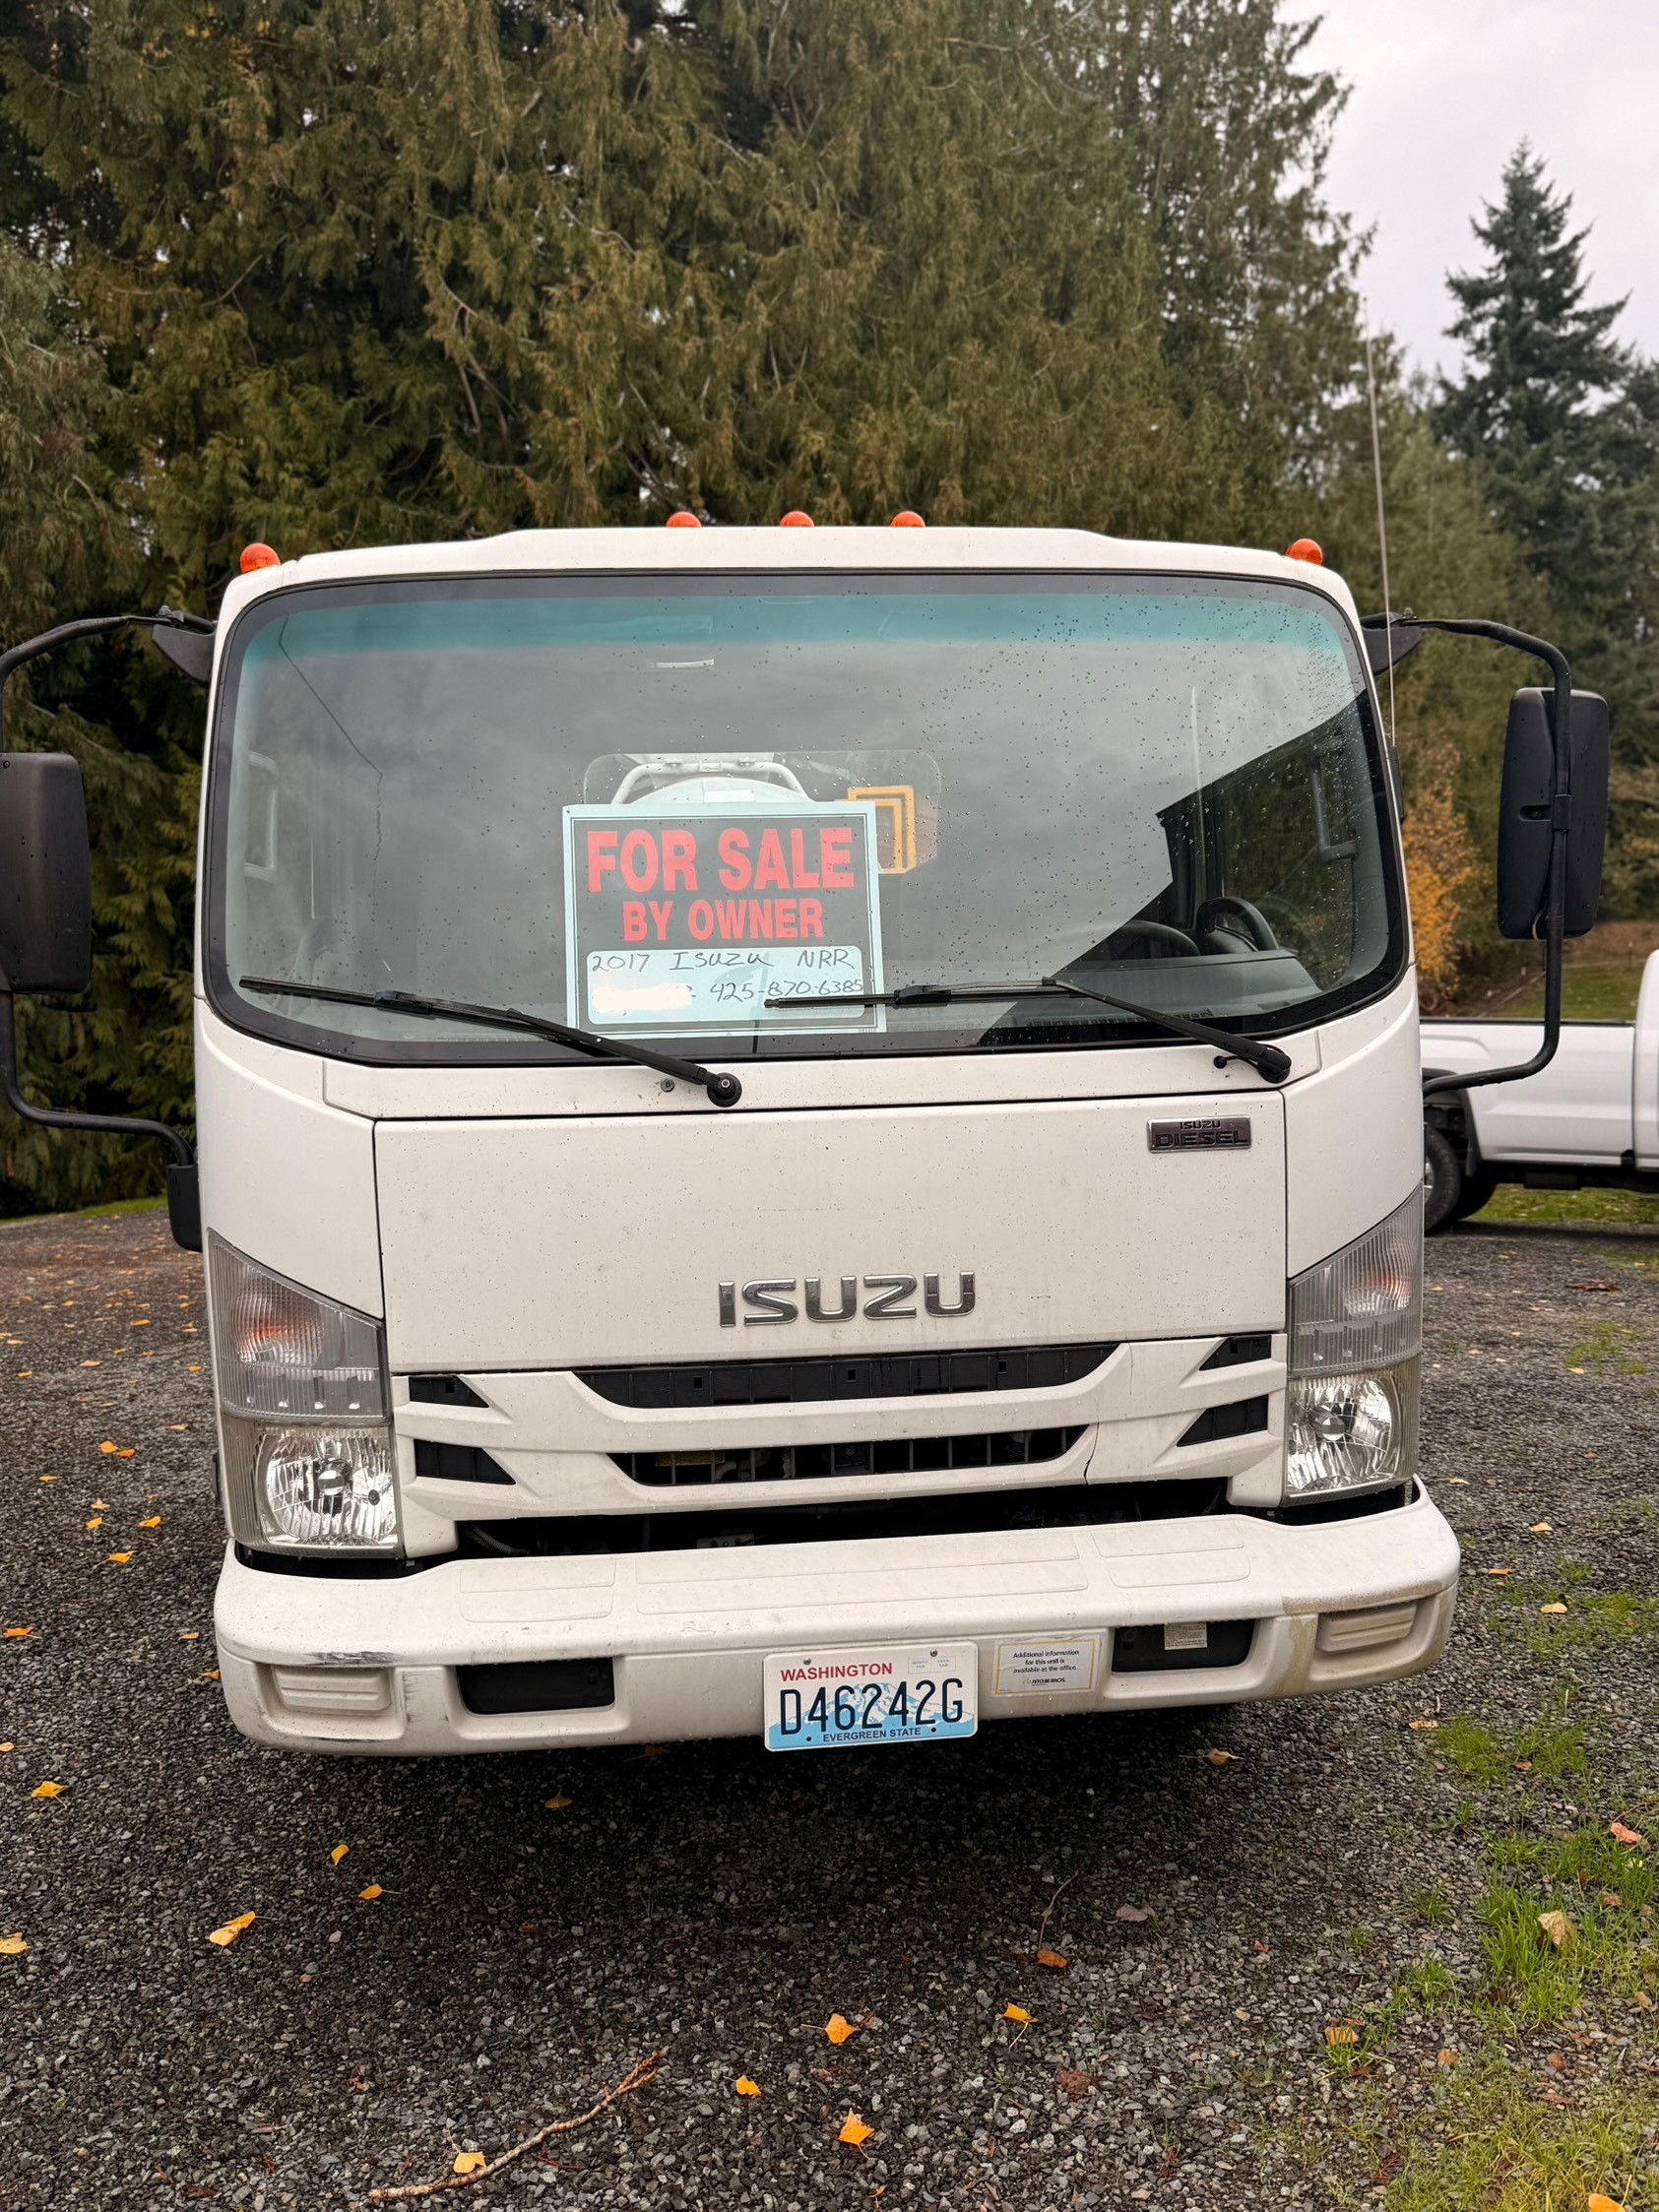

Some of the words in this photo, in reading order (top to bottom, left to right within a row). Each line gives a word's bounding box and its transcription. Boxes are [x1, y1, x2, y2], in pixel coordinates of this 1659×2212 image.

[587, 829, 698, 893] FOR
[718, 827, 856, 891] SALE
[623, 900, 673, 941] BY
[688, 898, 825, 940] OWNER
[591, 953, 651, 973] 2017
[797, 949, 856, 970] NRR
[1180, 1119, 1221, 1130] ISUZU
[1155, 1130, 1248, 1148] DIESEL
[718, 1270, 976, 1327] ISUZU
[781, 1663, 893, 1682] WASHINGTON
[780, 1677, 963, 1736] D46242G
[822, 1730, 887, 1743] EVERGREEN
[889, 1728, 922, 1738] STATE
